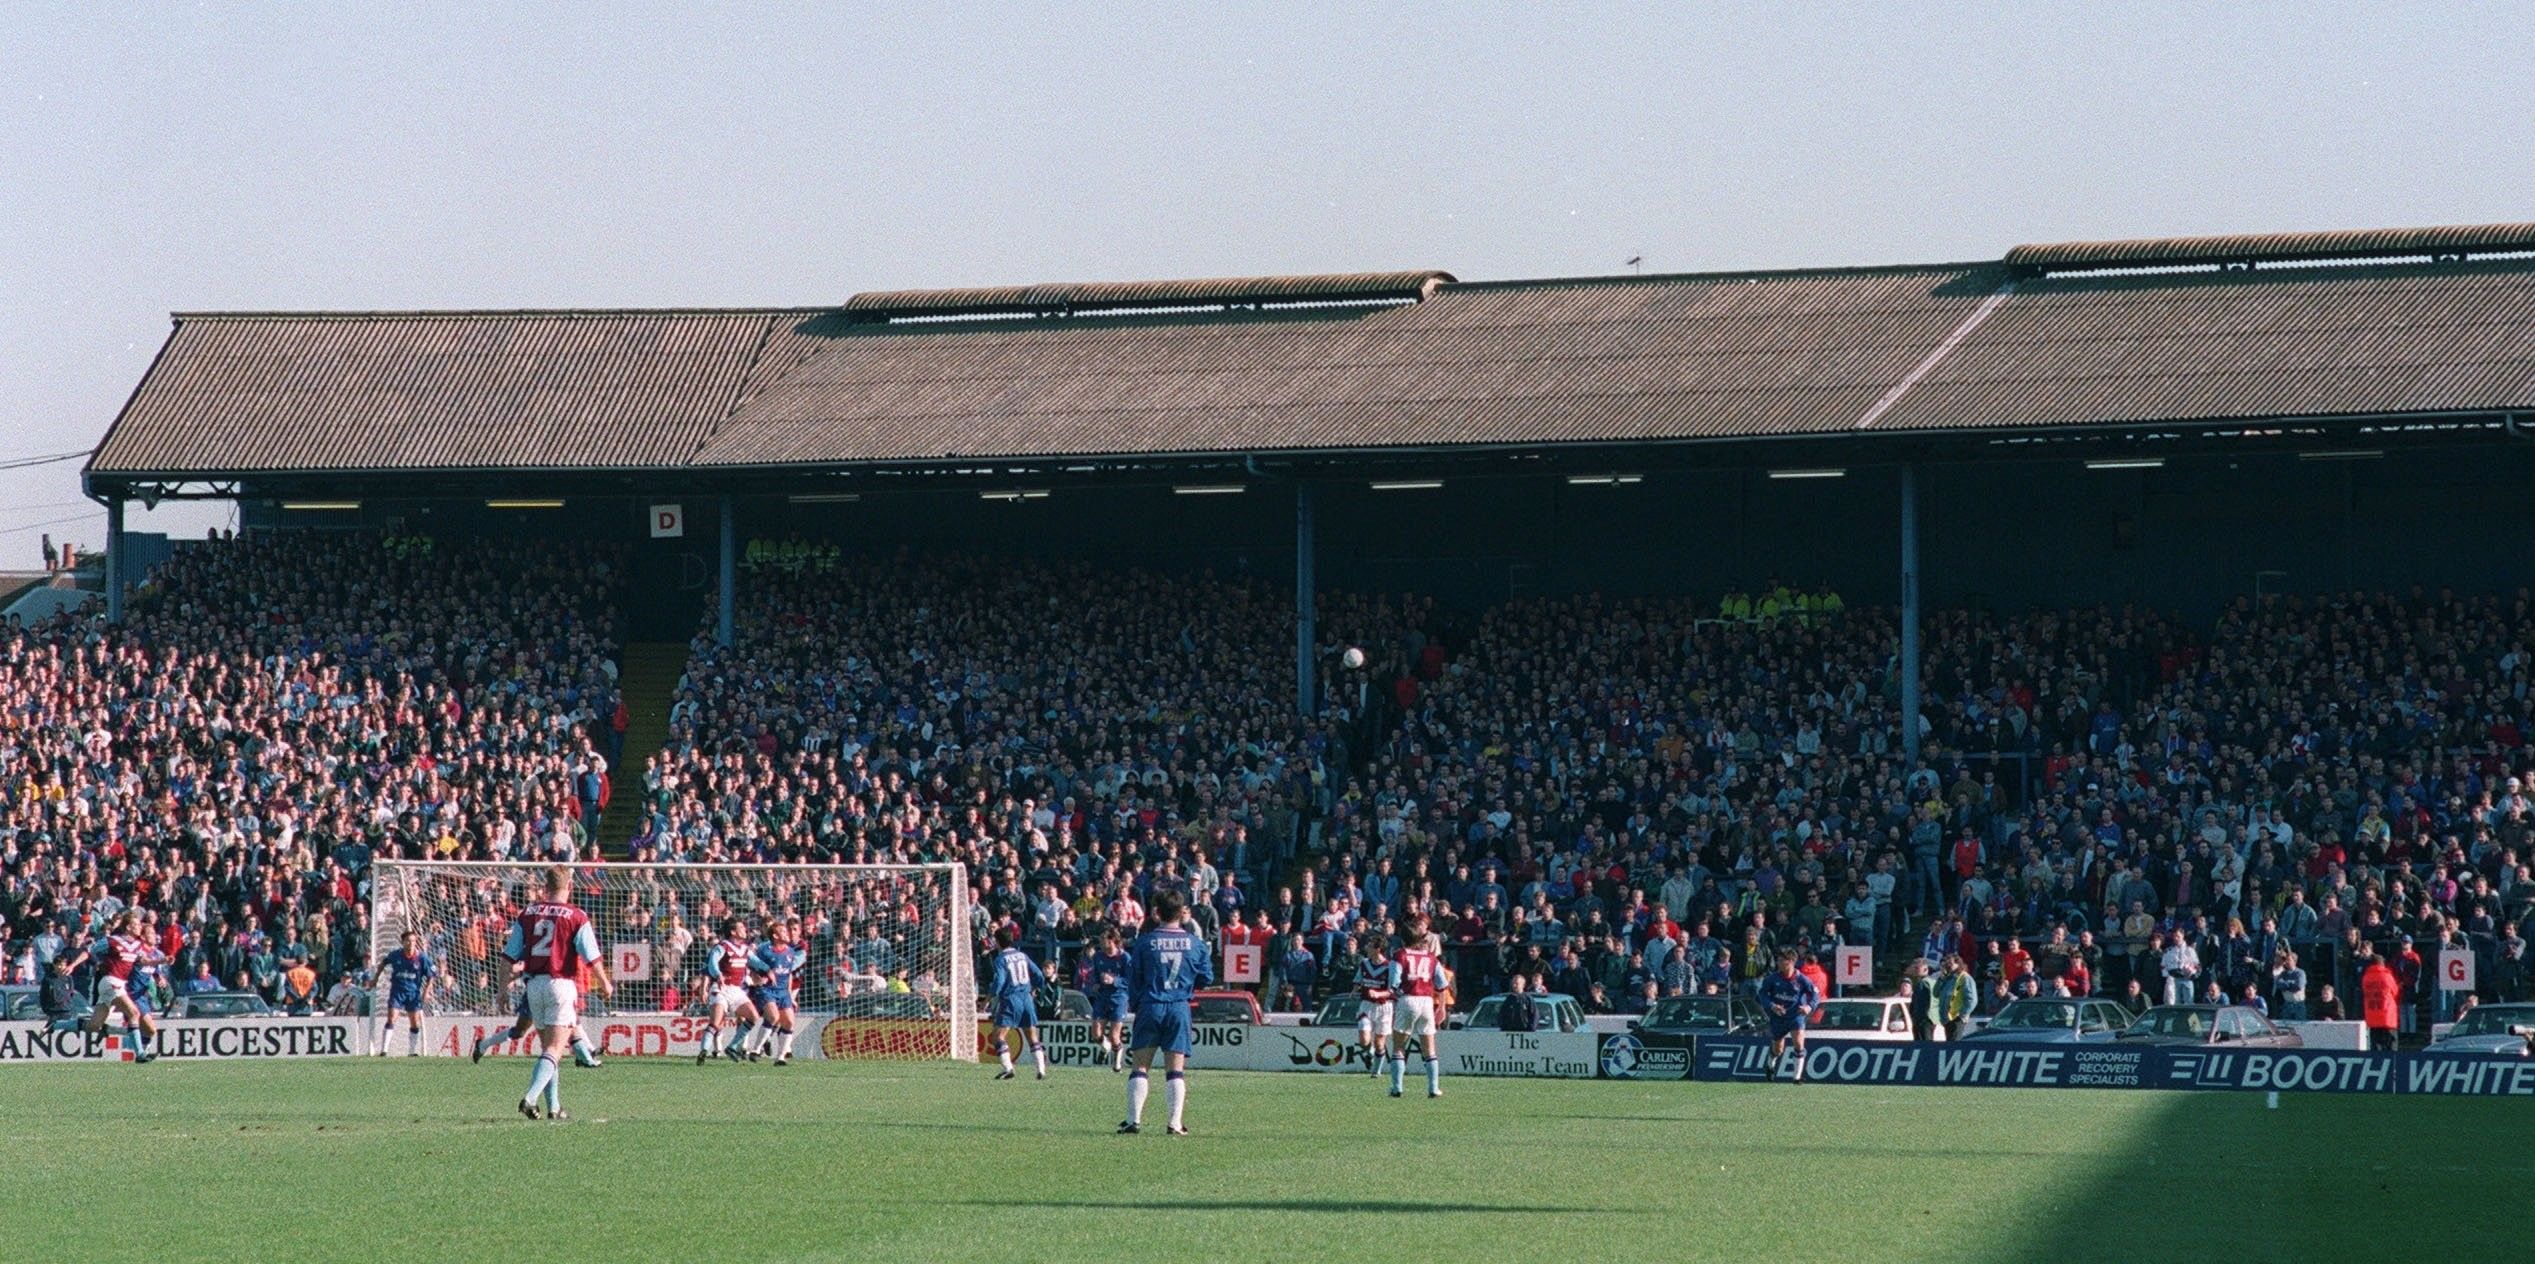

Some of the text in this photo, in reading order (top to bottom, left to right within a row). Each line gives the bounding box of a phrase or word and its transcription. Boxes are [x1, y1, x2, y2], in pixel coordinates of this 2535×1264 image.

[659, 512, 676, 530] D
[531, 918, 555, 957] 2
[1150, 938, 1192, 951] SPENCER
[623, 952, 641, 972] D
[1161, 951, 1182, 990] 7
[1235, 954, 1249, 974] E
[1407, 955, 1431, 982] 14
[1848, 955, 1860, 975] F
[2448, 960, 2465, 981] G
[1007, 959, 1029, 986] 10
[0, 1029, 103, 1059] ANCE
[157, 1025, 350, 1057] LEICESTER
[1506, 1033, 1539, 1050] The
[1460, 1055, 1588, 1074] Winning Team
[1776, 1046, 2065, 1083] BOOTH WHITE
[2075, 1052, 2141, 1063] CORPORATE
[2078, 1063, 2138, 1074] RECOVERY
[2241, 1055, 2535, 1095] BOOTH WHITE
[2069, 1074, 2139, 1085] SPECIALISTS
